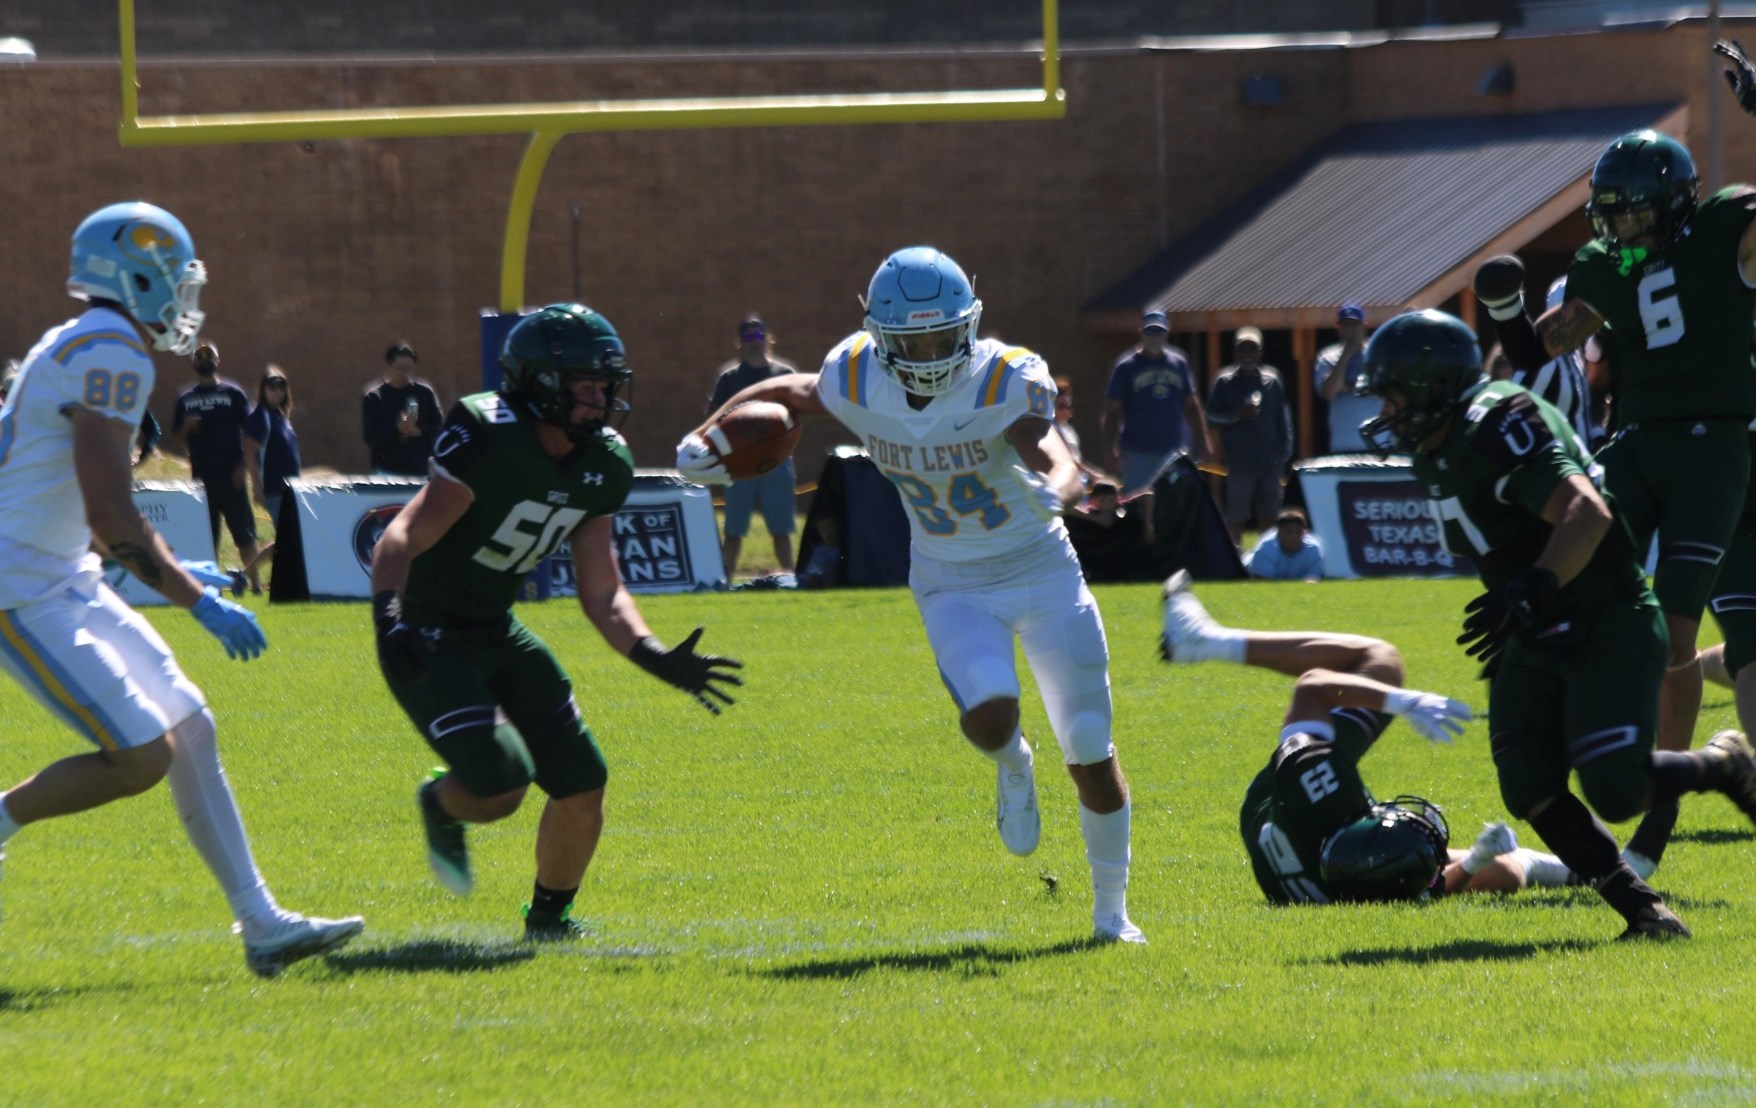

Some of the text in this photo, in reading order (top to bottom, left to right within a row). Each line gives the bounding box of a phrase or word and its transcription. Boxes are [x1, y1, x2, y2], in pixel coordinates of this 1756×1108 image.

[1637, 266, 1686, 350] 6
[84, 368, 141, 412] 88
[1025, 380, 1055, 417] 8
[867, 433, 989, 472] FORT LEWIS
[141, 503, 168, 514] PHY
[885, 469, 1012, 536] 84
[1356, 502, 1432, 520] SERIOU
[644, 514, 671, 527] OF
[1369, 526, 1438, 544] TEXAS
[471, 499, 587, 575] 50
[624, 535, 677, 560] AN
[1365, 547, 1454, 567] BAR-B-Q
